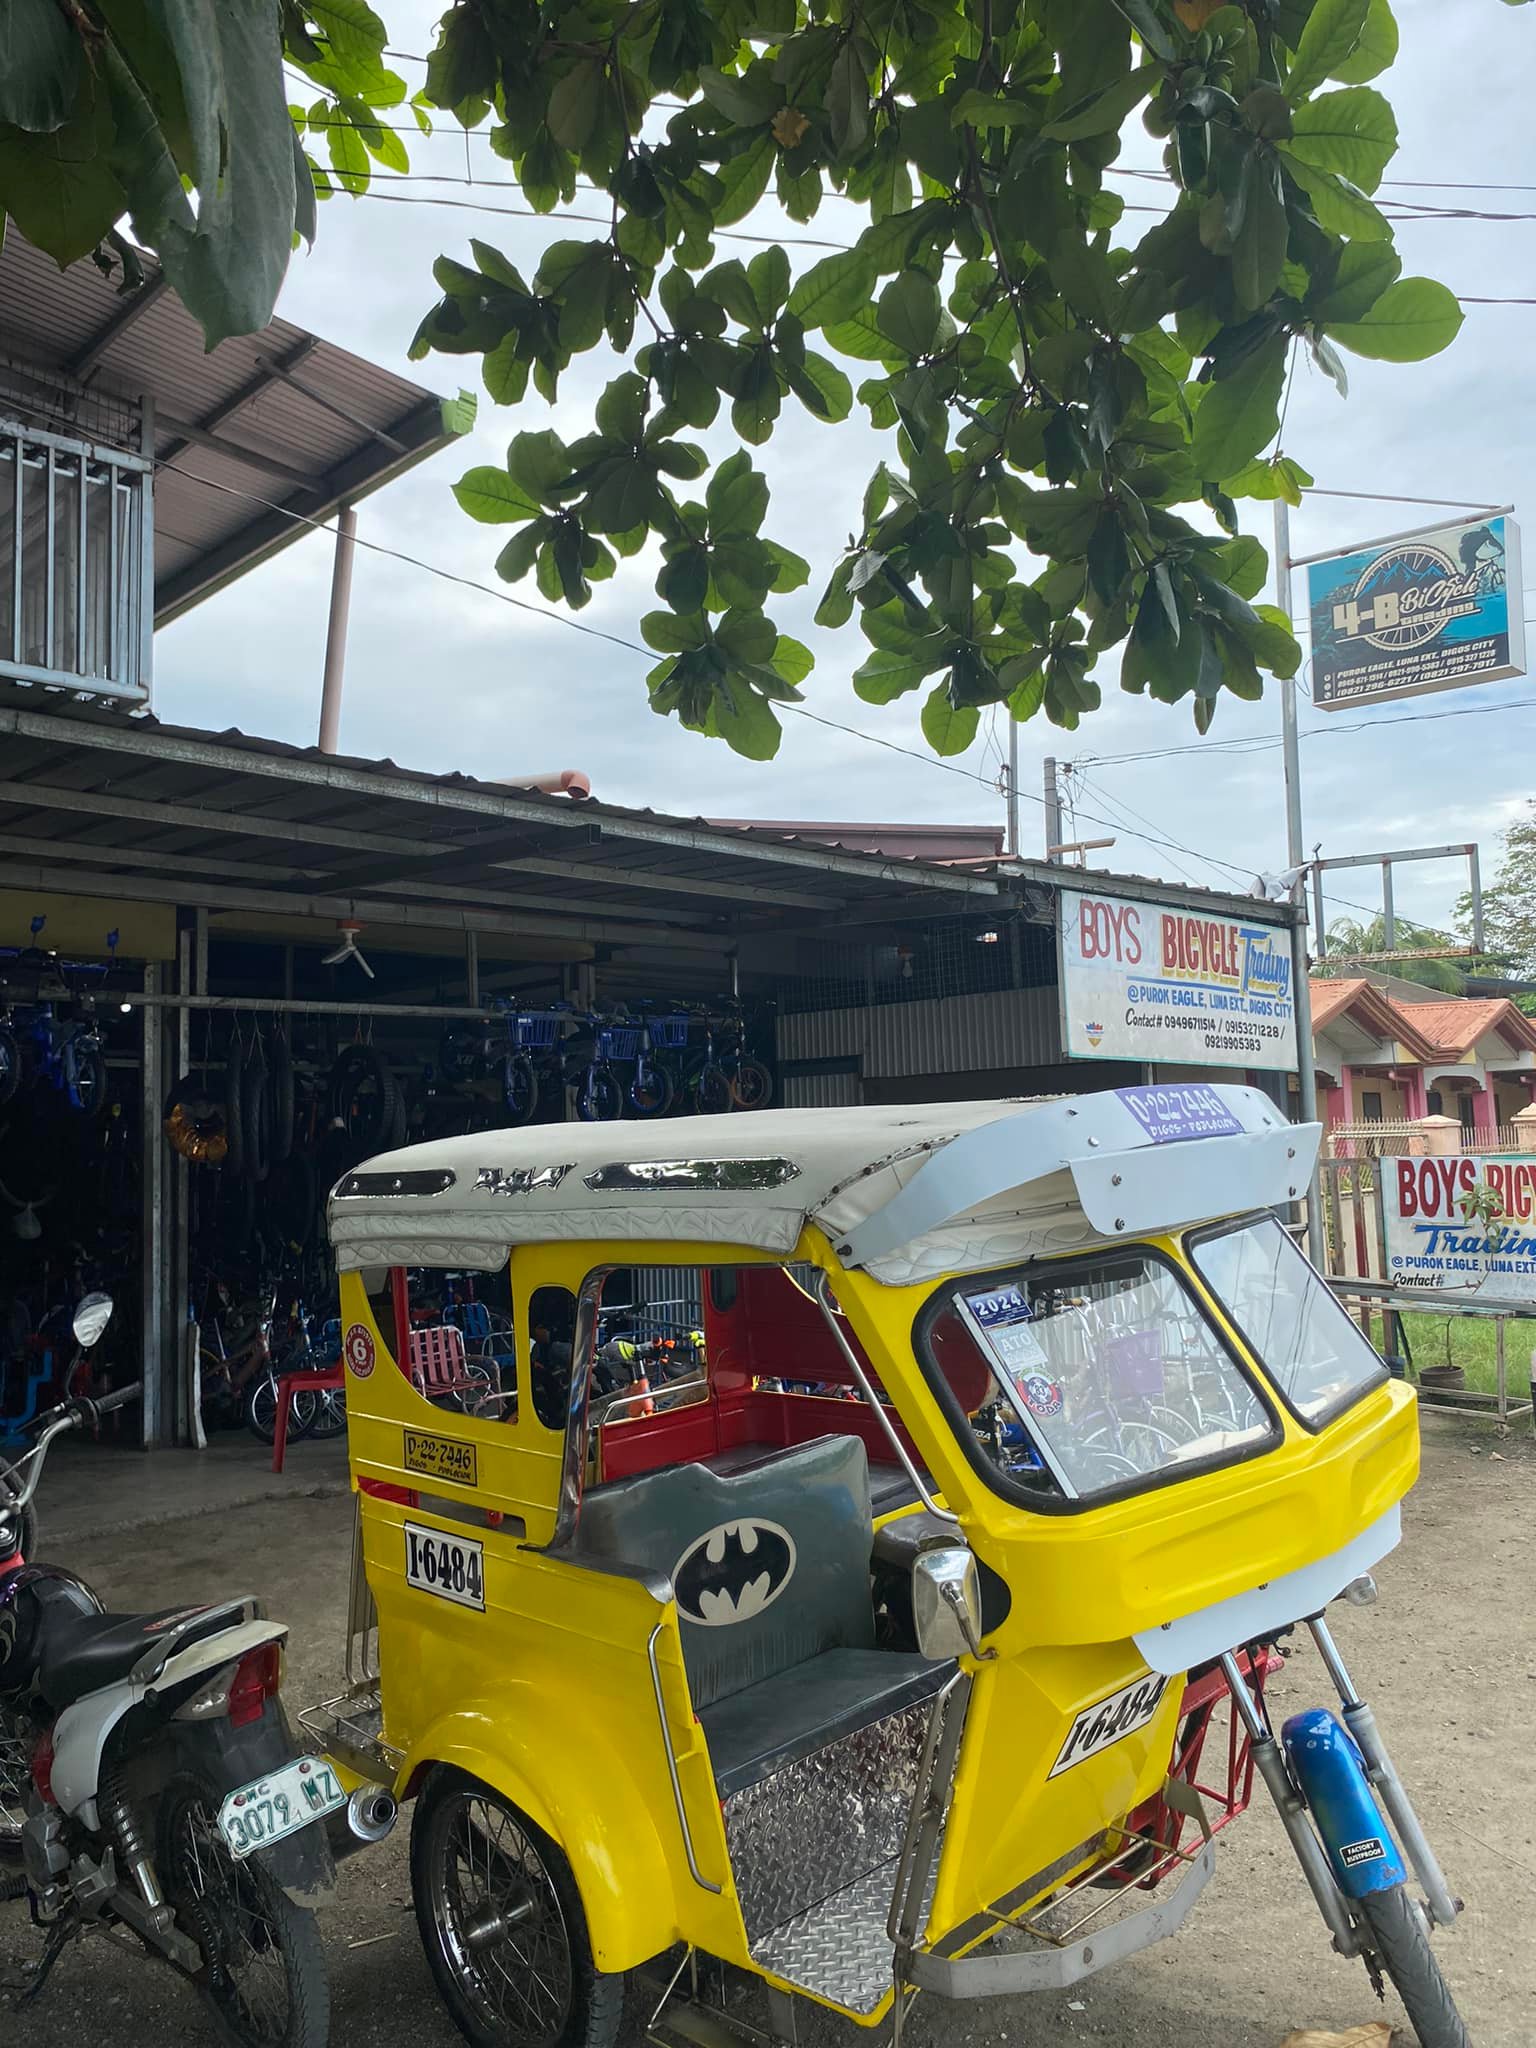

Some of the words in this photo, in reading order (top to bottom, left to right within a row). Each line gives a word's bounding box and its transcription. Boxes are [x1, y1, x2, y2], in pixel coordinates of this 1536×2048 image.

[1337, 667, 1367, 679] PUROK
[1396, 655, 1419, 666] LUNA
[1441, 644, 1471, 657] DIGOS
[1472, 639, 1496, 651] CITY
[1449, 658, 1497, 675] 297-7917
[1079, 899, 1142, 965] BOYS
[1161, 913, 1240, 978] BICYCLE
[1239, 928, 1291, 997] Trading
[1171, 989, 1208, 1010] EAGLE,
[1209, 993, 1229, 1011] LUNA
[1249, 999, 1273, 1017] DIGOS
[1273, 1002, 1292, 1019] CITY
[1225, 1020, 1280, 1039] 09153271228
[1397, 1158, 1477, 1218] BOYS
[1405, 1256, 1444, 1270] PUROK
[1485, 1259, 1514, 1273] LUNA
[975, 1292, 1022, 1316] 2024
[352, 1338, 367, 1361] 6
[227, 1793, 290, 1849] 3079
[300, 1770, 341, 1811] MZ
[1347, 1841, 1375, 1855] FACTORY
